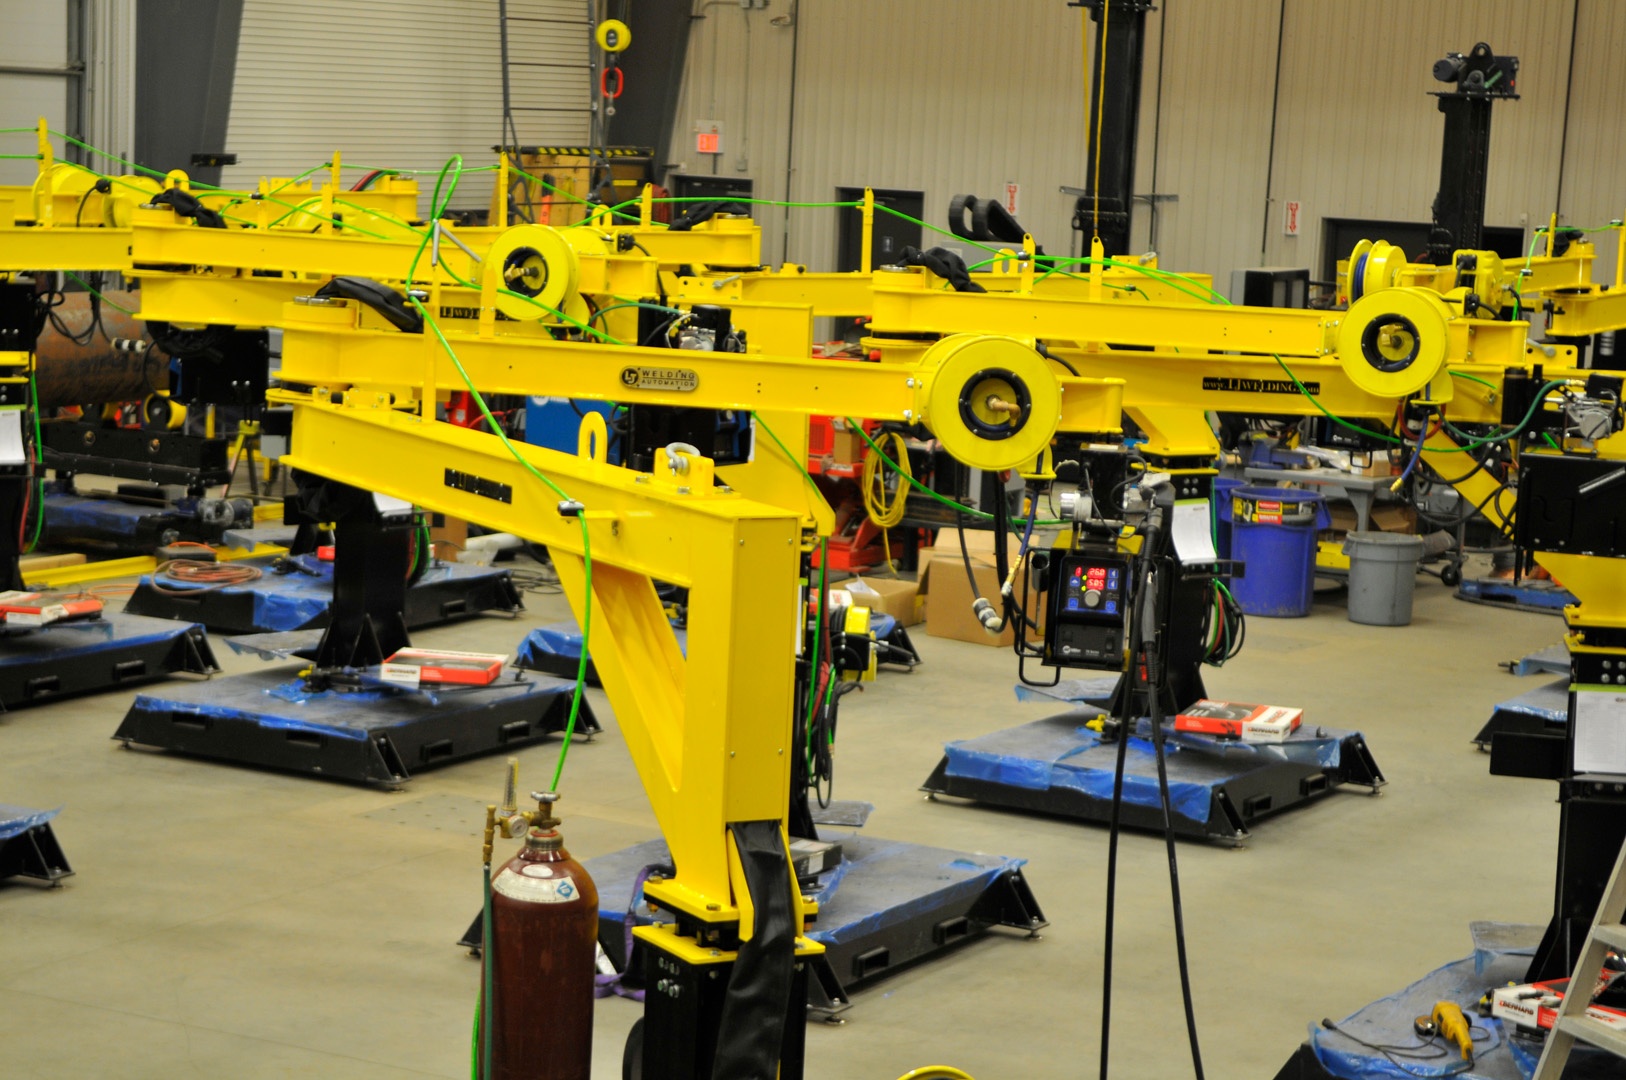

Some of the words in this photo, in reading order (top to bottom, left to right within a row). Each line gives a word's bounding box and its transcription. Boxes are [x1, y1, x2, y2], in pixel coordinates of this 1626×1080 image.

[642, 370, 695, 379] WELDING
[641, 379, 695, 387] AUTOMATION
[1203, 378, 1319, 393] www.LJWELDING.om
